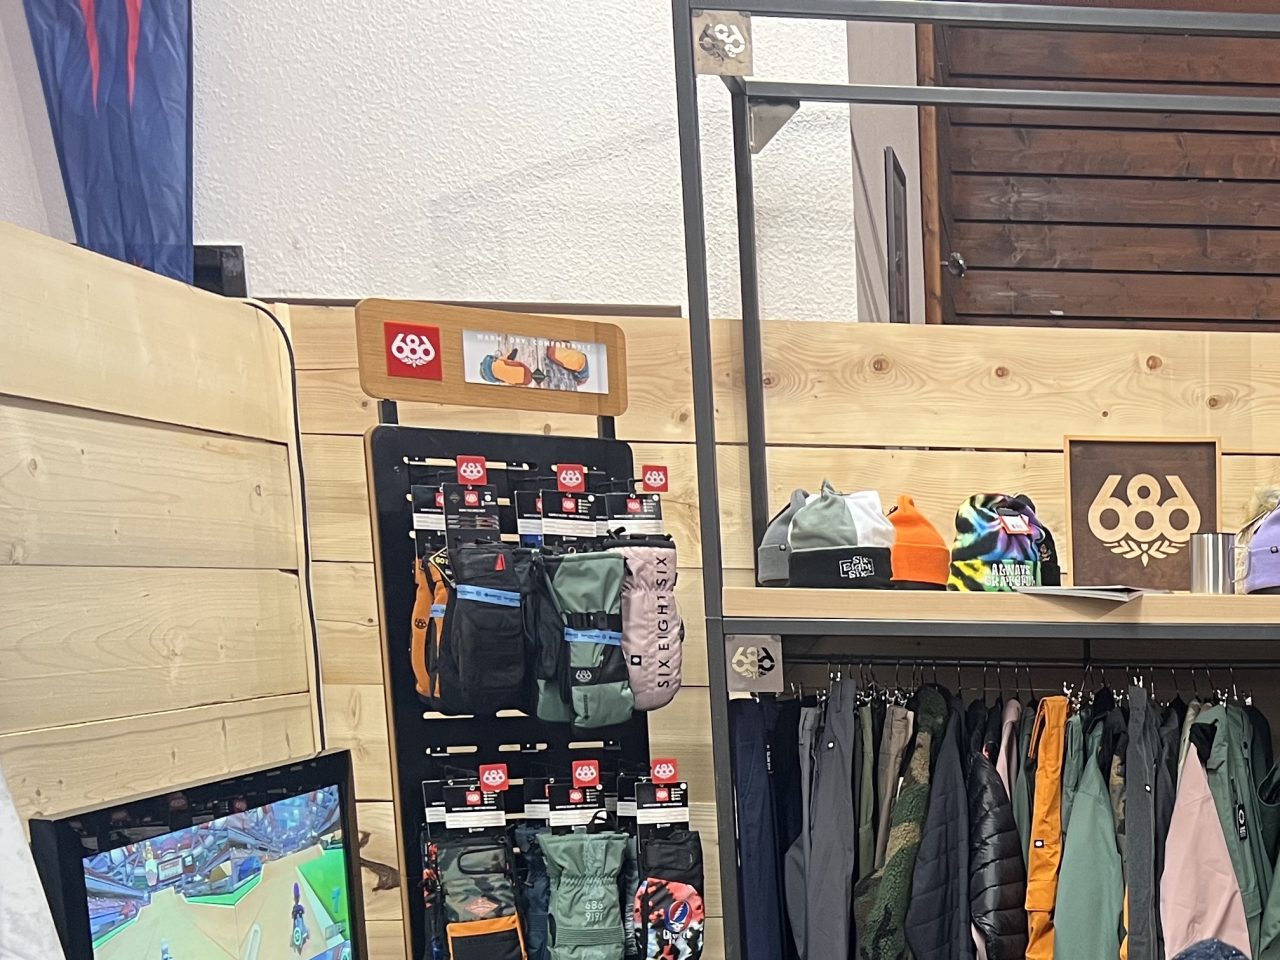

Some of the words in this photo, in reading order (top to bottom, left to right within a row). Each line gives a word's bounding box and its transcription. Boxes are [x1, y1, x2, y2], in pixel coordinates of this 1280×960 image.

[391, 333, 436, 362] 686
[460, 462, 484, 478] 686
[560, 469, 582, 485] 686
[645, 470, 666, 486] 686
[1087, 473, 1201, 543] 686
[656, 557, 668, 586] SIX
[992, 563, 1031, 576] ALWAYS
[657, 595, 670, 650] EIGHT
[731, 646, 775, 672] 686
[658, 659, 671, 688] SIX
[483, 769, 505, 785] 686
[575, 766, 597, 781] 686
[654, 763, 675, 778] 686
[585, 900, 604, 910] 686
